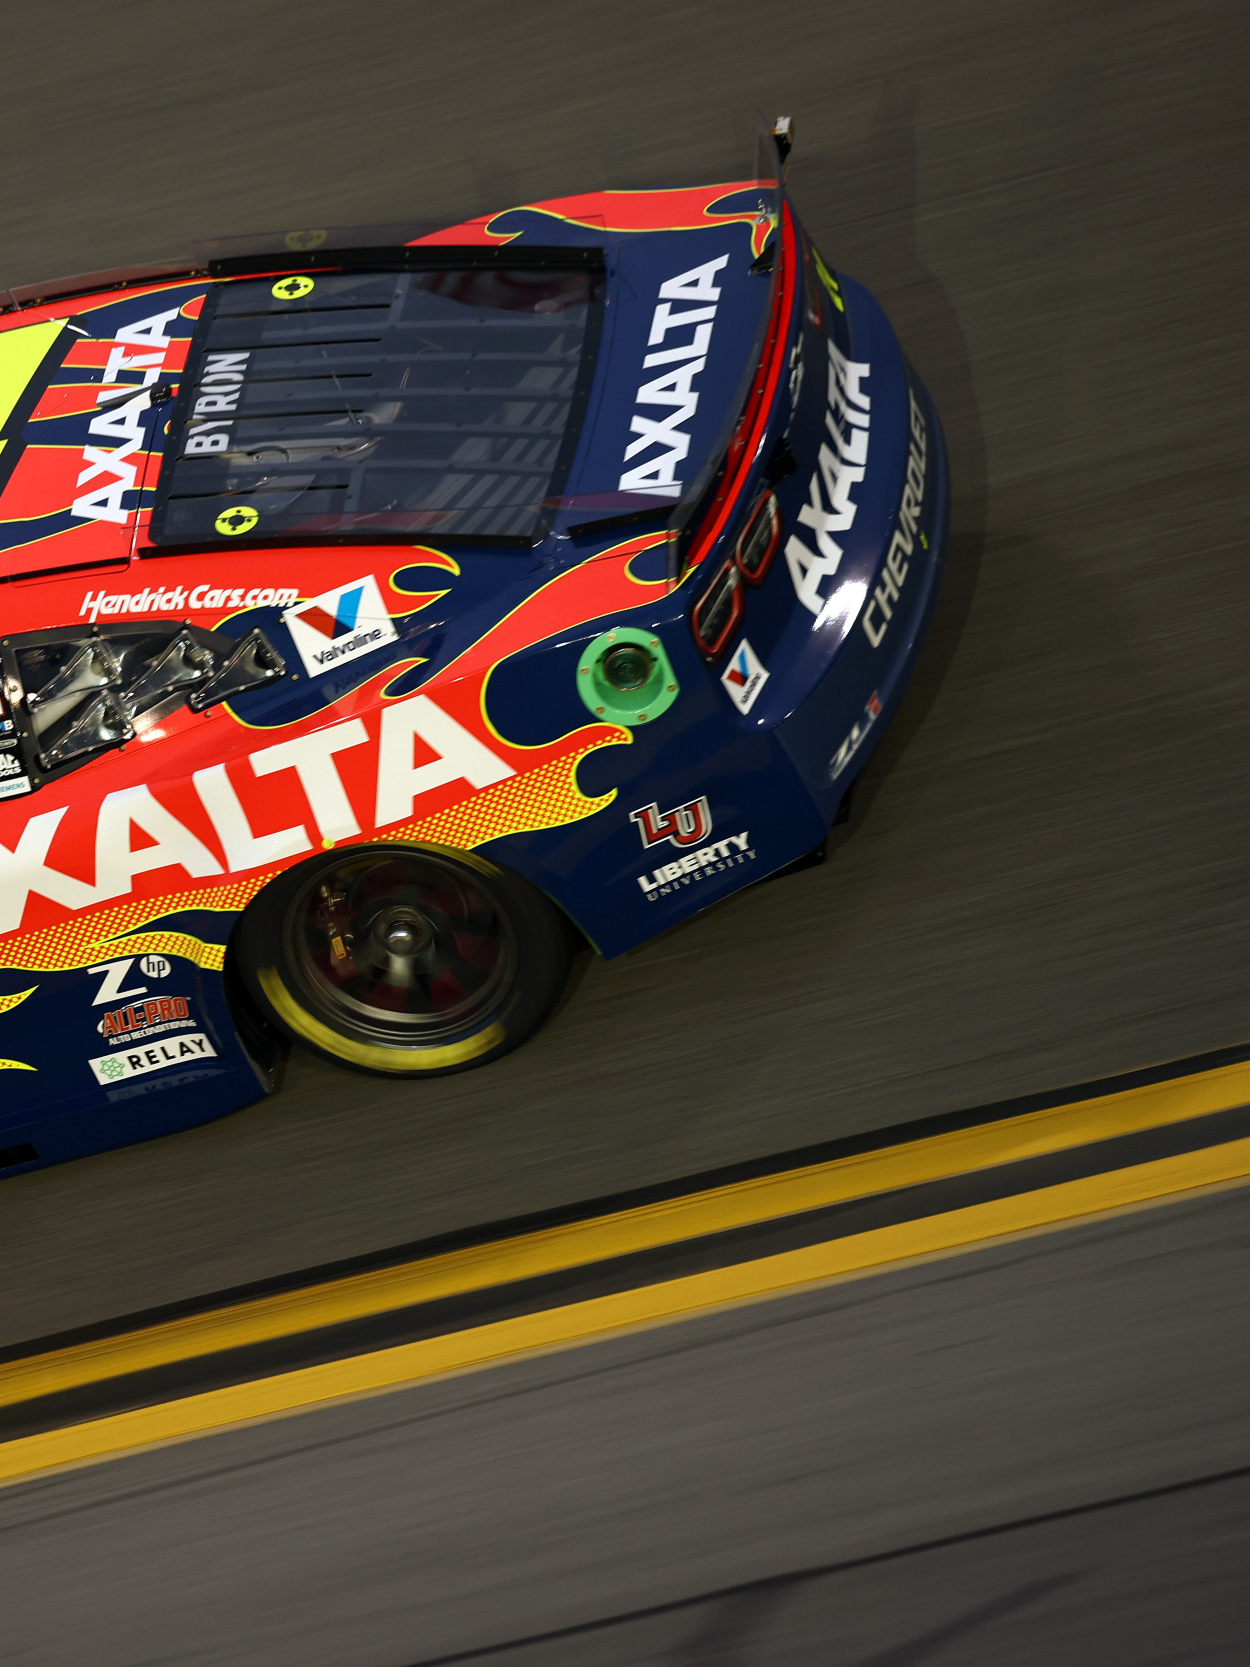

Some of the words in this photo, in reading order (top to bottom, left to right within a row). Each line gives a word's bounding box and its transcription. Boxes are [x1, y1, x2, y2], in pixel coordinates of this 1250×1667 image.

[184, 352, 250, 457] BYRON
[619, 254, 730, 497] AXALTA
[71, 307, 181, 524] AXALTA
[784, 337, 870, 617] AXALTA
[862, 386, 927, 648] CHEVROLET
[312, 627, 382, 665] Valvoline
[637, 831, 749, 893] LIBERTY
[646, 849, 756, 901] UNIVERSITY
[102, 997, 190, 1037] ALL-PRO
[108, 1033, 131, 1046] AUTO
[127, 1038, 206, 1071] RELAY
